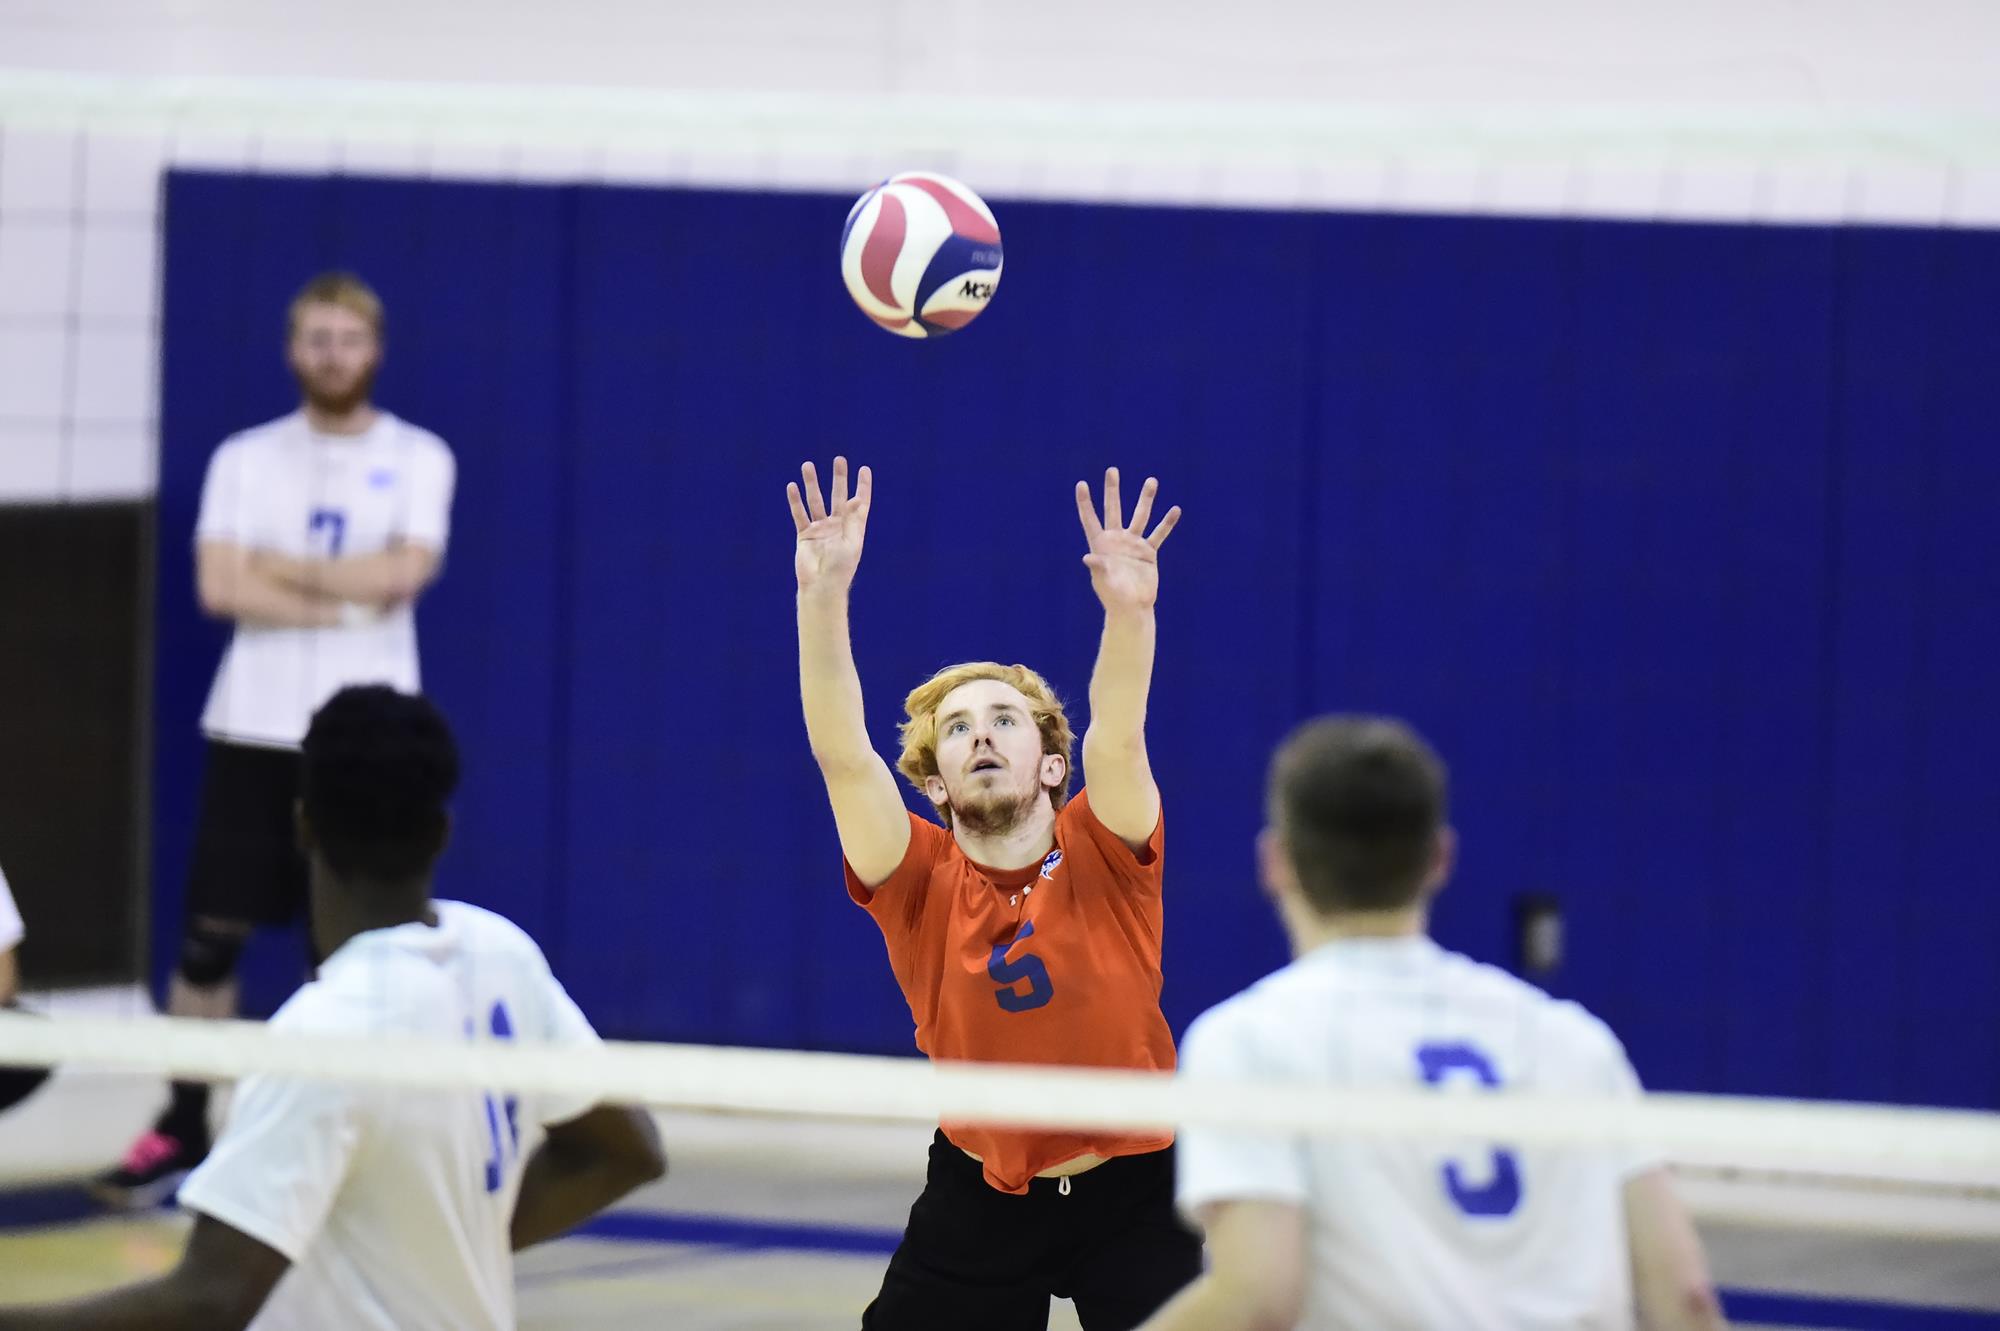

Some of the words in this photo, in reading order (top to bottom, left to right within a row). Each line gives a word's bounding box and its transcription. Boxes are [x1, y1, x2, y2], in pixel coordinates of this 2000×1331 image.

[959, 280, 994, 298] NCA
[310, 508, 345, 559] 7
[987, 919, 1055, 1013] 5
